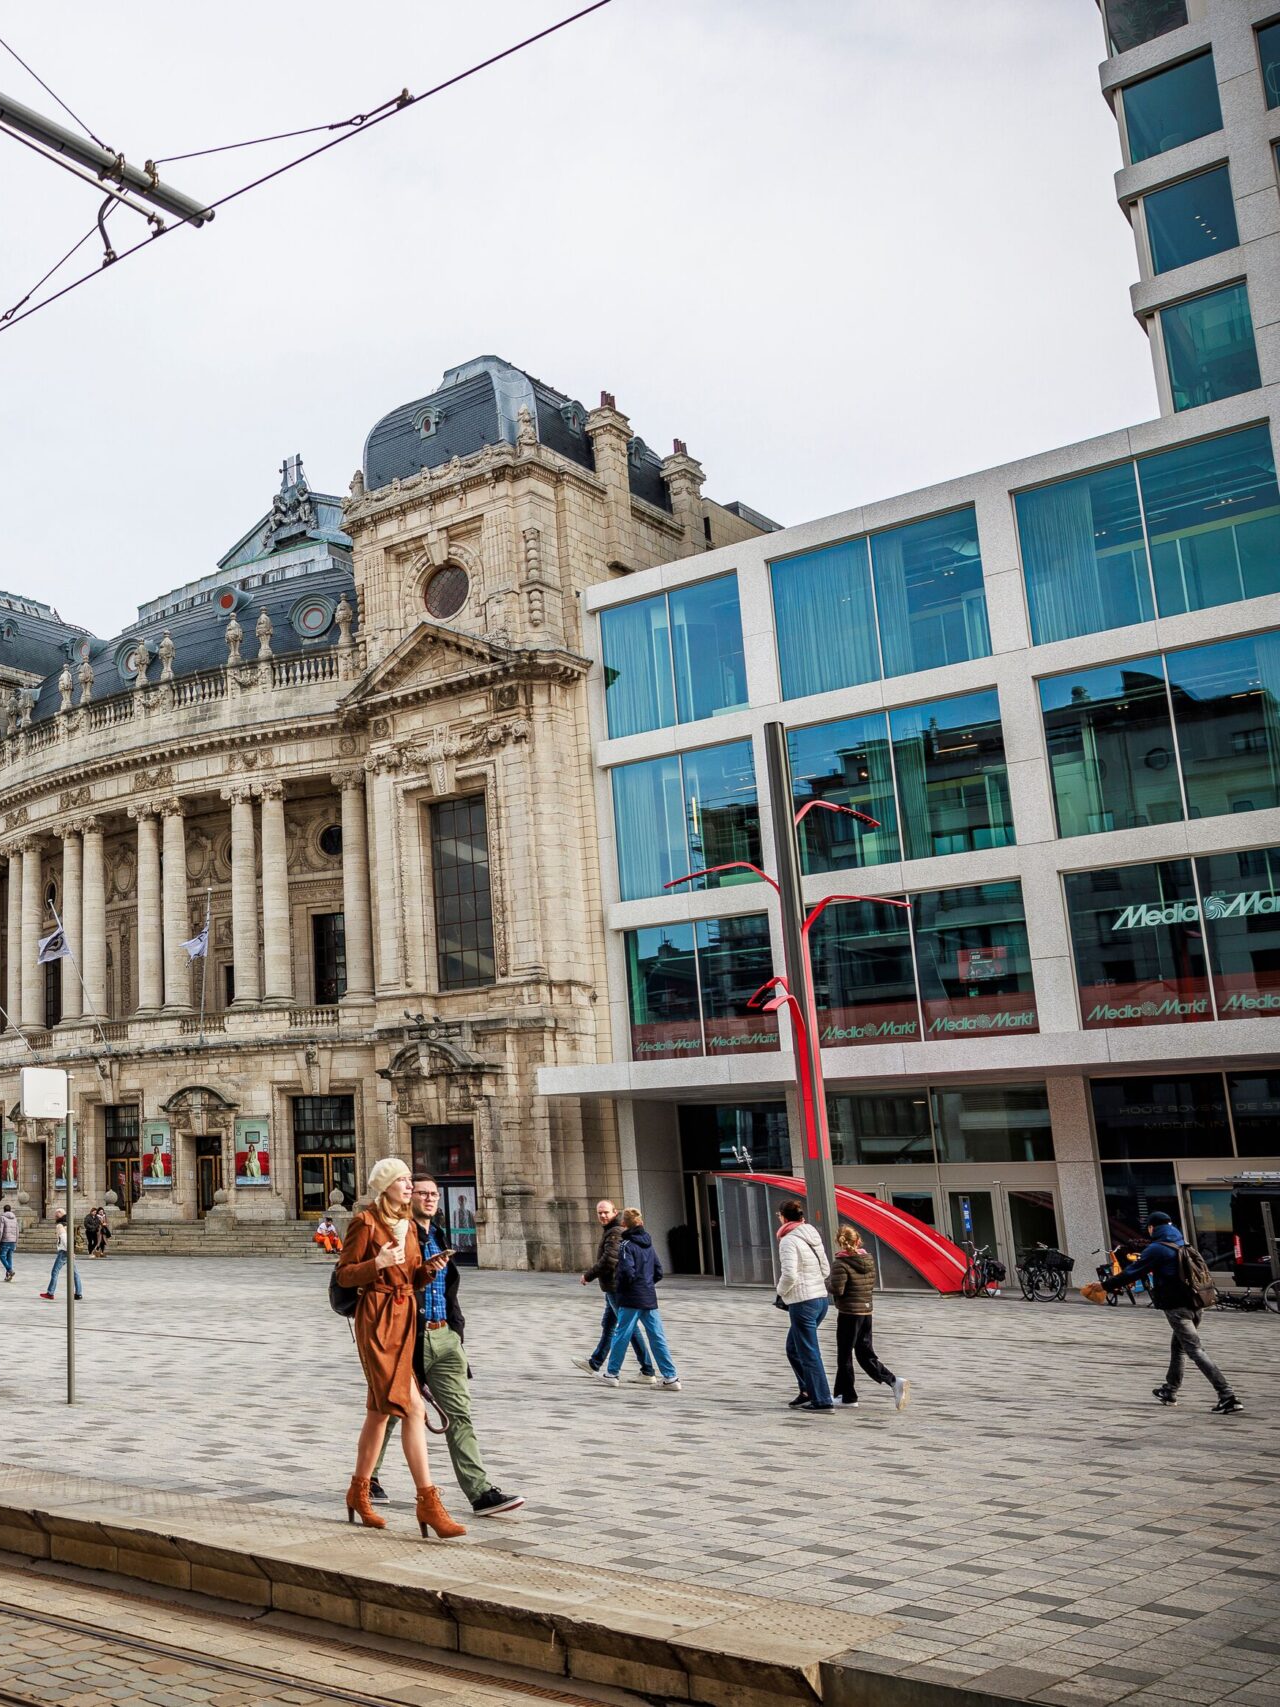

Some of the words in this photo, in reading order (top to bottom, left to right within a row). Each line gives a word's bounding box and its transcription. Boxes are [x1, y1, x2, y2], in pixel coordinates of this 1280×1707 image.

[1111, 903, 1199, 931] Media
[1087, 1004, 1141, 1021] Media
[1155, 998, 1208, 1016] Markt
[820, 1025, 864, 1041] Media
[875, 1021, 918, 1036] Markt
[928, 1016, 977, 1033] Media
[988, 1012, 1035, 1029] Markt
[635, 1041, 665, 1053] Media
[672, 1038, 702, 1050] Markt
[708, 1035, 740, 1048] Media
[748, 1032, 778, 1046] Markt
[1235, 1102, 1258, 1112] DE
